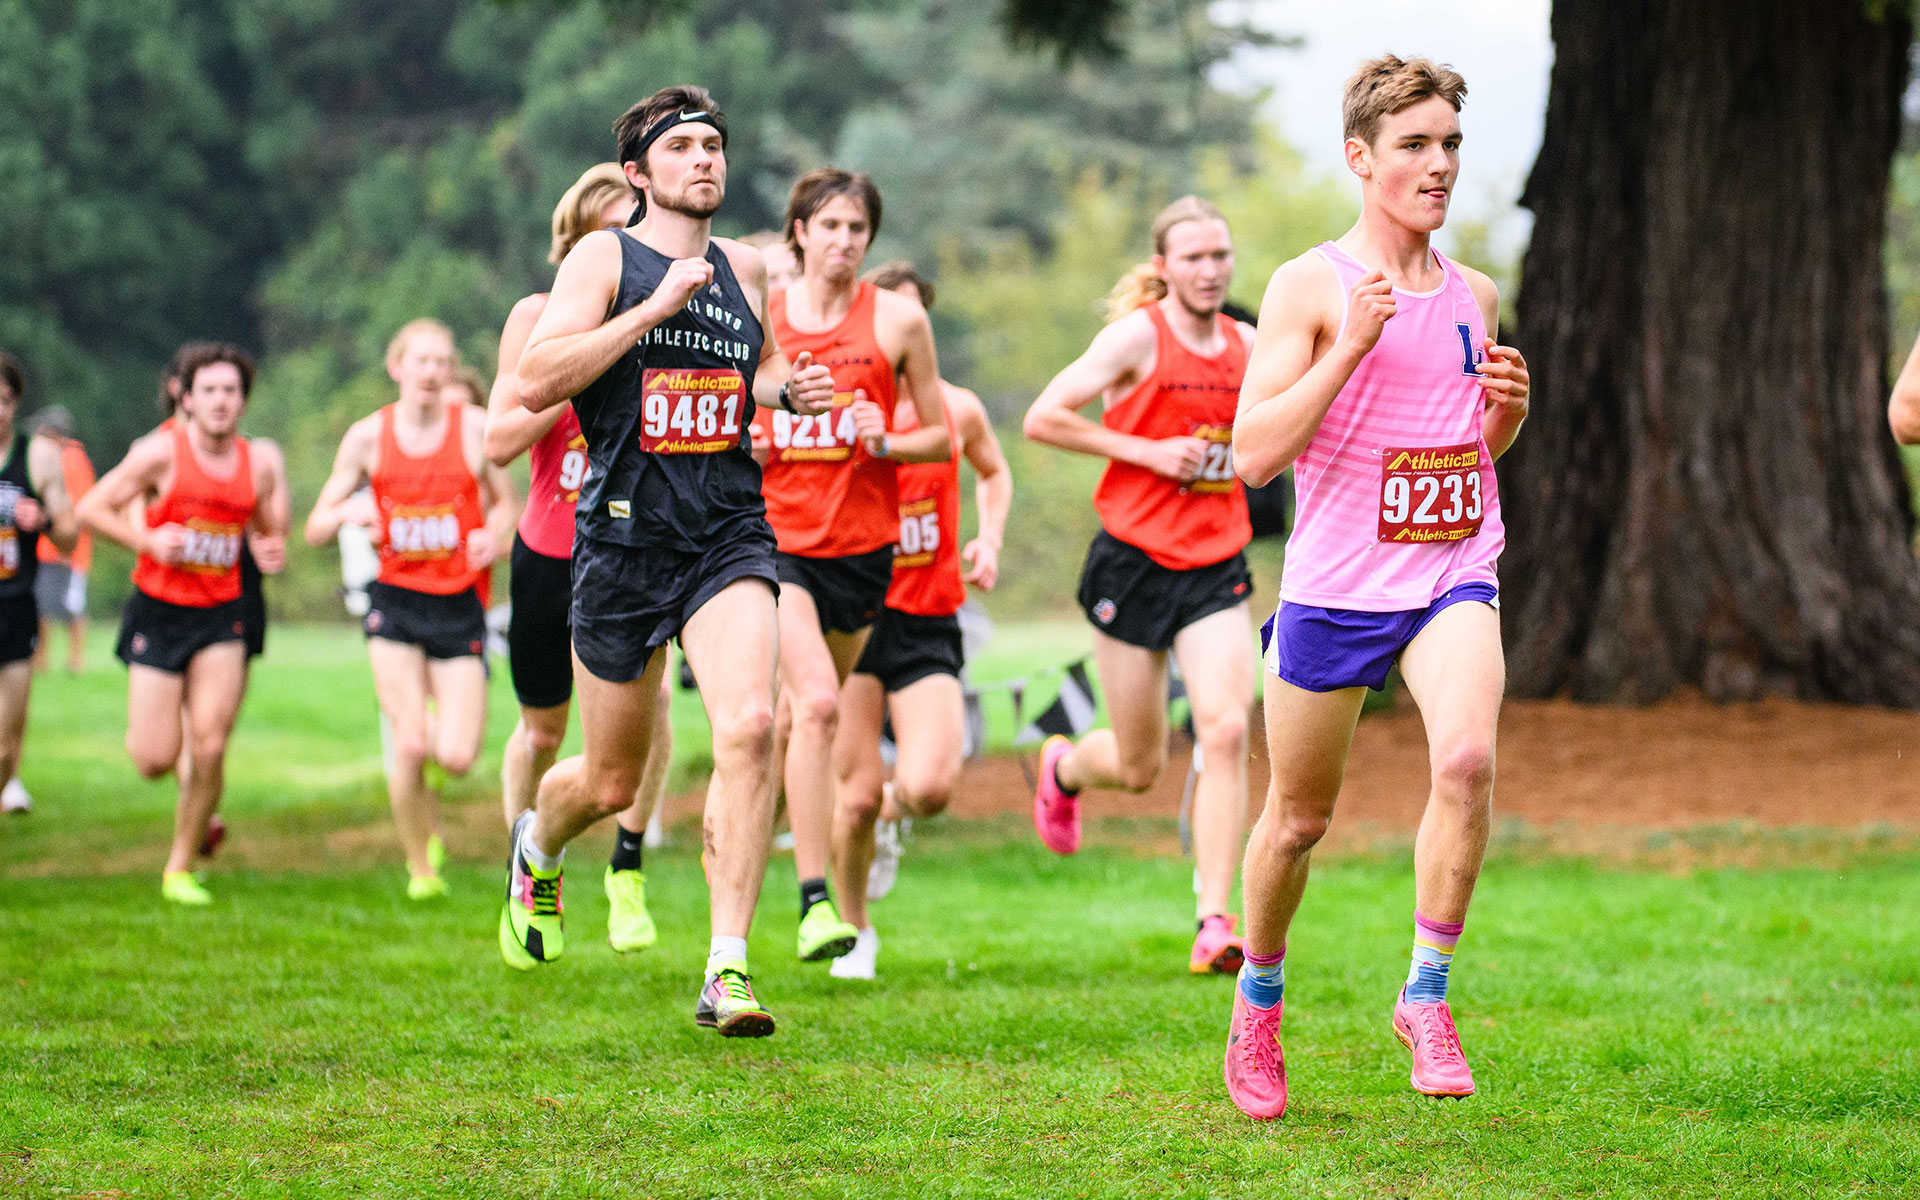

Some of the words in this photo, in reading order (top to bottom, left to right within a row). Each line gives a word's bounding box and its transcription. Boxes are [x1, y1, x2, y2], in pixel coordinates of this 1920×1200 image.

[705, 303, 742, 331] BOYS
[713, 339, 750, 361] CLUB
[644, 393, 739, 438] 9481
[772, 407, 857, 449] 9214
[1462, 452, 1478, 465] NET
[1382, 471, 1482, 524] 9233
[892, 512, 940, 556] 05
